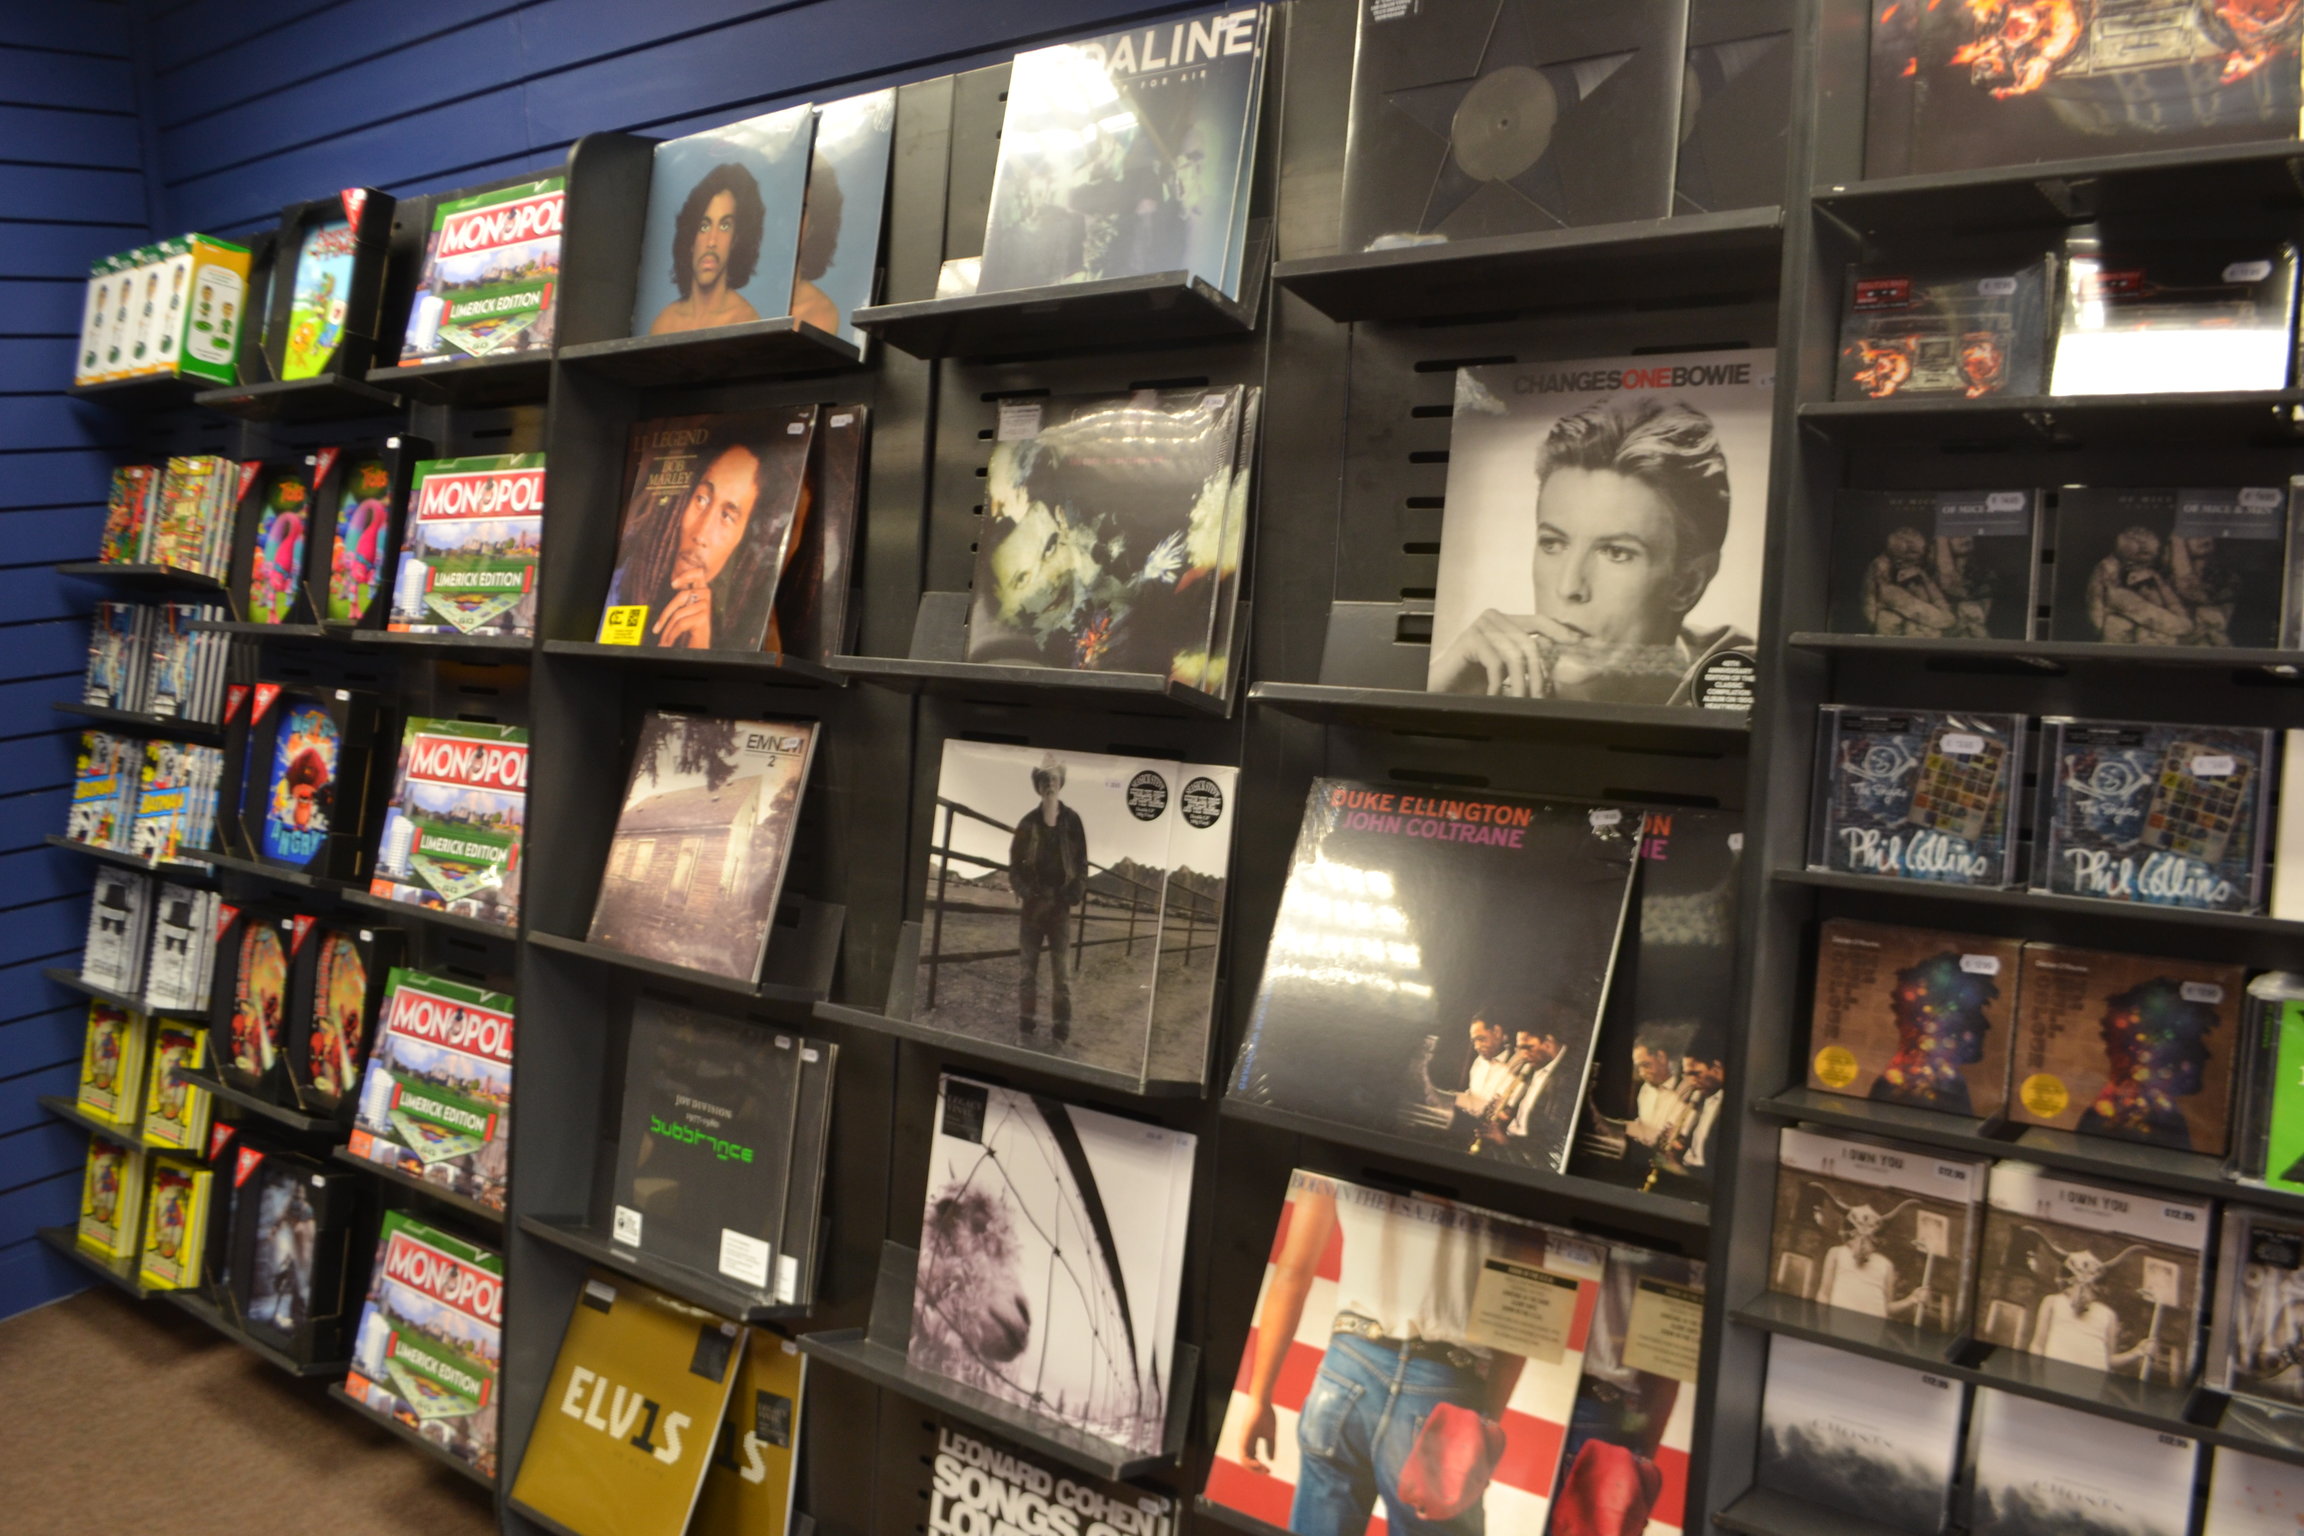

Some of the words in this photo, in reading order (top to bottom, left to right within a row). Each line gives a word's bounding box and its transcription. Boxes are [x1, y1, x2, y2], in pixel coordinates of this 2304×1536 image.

[443, 198, 565, 254] MONOPOL
[450, 298, 495, 319] LIMERICK
[496, 291, 541, 311] EDITION
[422, 477, 544, 515] MONOPOL
[434, 572, 479, 586] LIMERICK
[480, 572, 523, 586] EDITION
[411, 742, 528, 788] MONOPOL
[767, 755, 776, 767] 2
[1331, 788, 1395, 813] DUKE
[1398, 797, 1533, 827] ELLINGTON
[420, 835, 465, 856] LIMERICK
[465, 843, 507, 862] EDITION
[1342, 811, 1402, 835] JOHN
[1405, 818, 1526, 849] COLTRANE
[1840, 827, 1901, 871] Phil
[1905, 830, 1987, 876] Collins
[2063, 848, 2134, 895] Phil
[2138, 852, 2231, 902] Collins
[392, 998, 514, 1059] MONOPOL
[400, 1091, 444, 1118] LIMERICK
[443, 1105, 486, 1132] EDITION
[1849, 1148, 1877, 1164] OWN
[1879, 1155, 1904, 1169] YOU
[2101, 1198, 2129, 1213] YOU
[389, 1244, 503, 1323] MONOPOL
[395, 1340, 439, 1375] LIMERICK
[438, 1360, 481, 1396] EDITION
[932, 1454, 1080, 1536] SONGS
[938, 1427, 1054, 1498] LEONARD
[1055, 1479, 1155, 1536] COHEN
